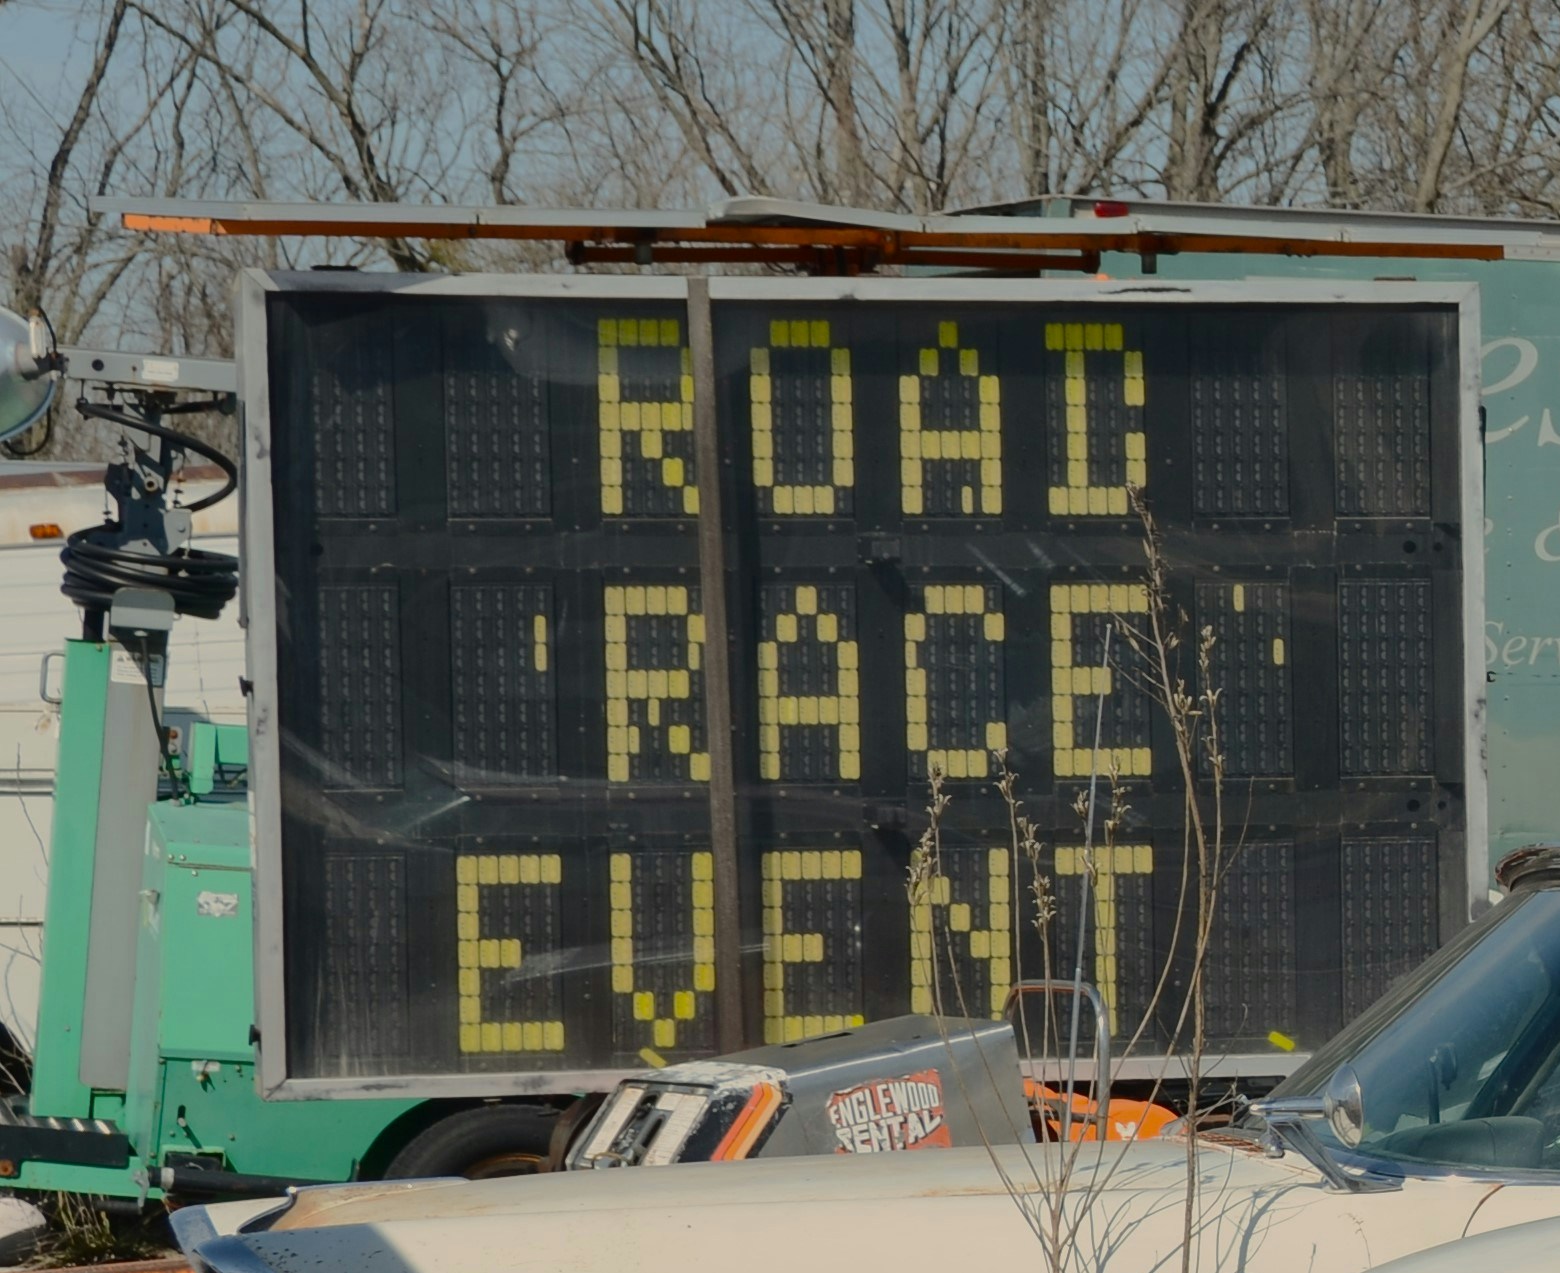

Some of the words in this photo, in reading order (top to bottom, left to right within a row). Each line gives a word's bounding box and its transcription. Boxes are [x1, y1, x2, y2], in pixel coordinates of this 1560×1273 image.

[598, 318, 1147, 515] ROAD
[457, 846, 1153, 1052] EVENT
[829, 1081, 941, 1129] ENGLEWOOD
[835, 1110, 942, 1153] RENTAL
